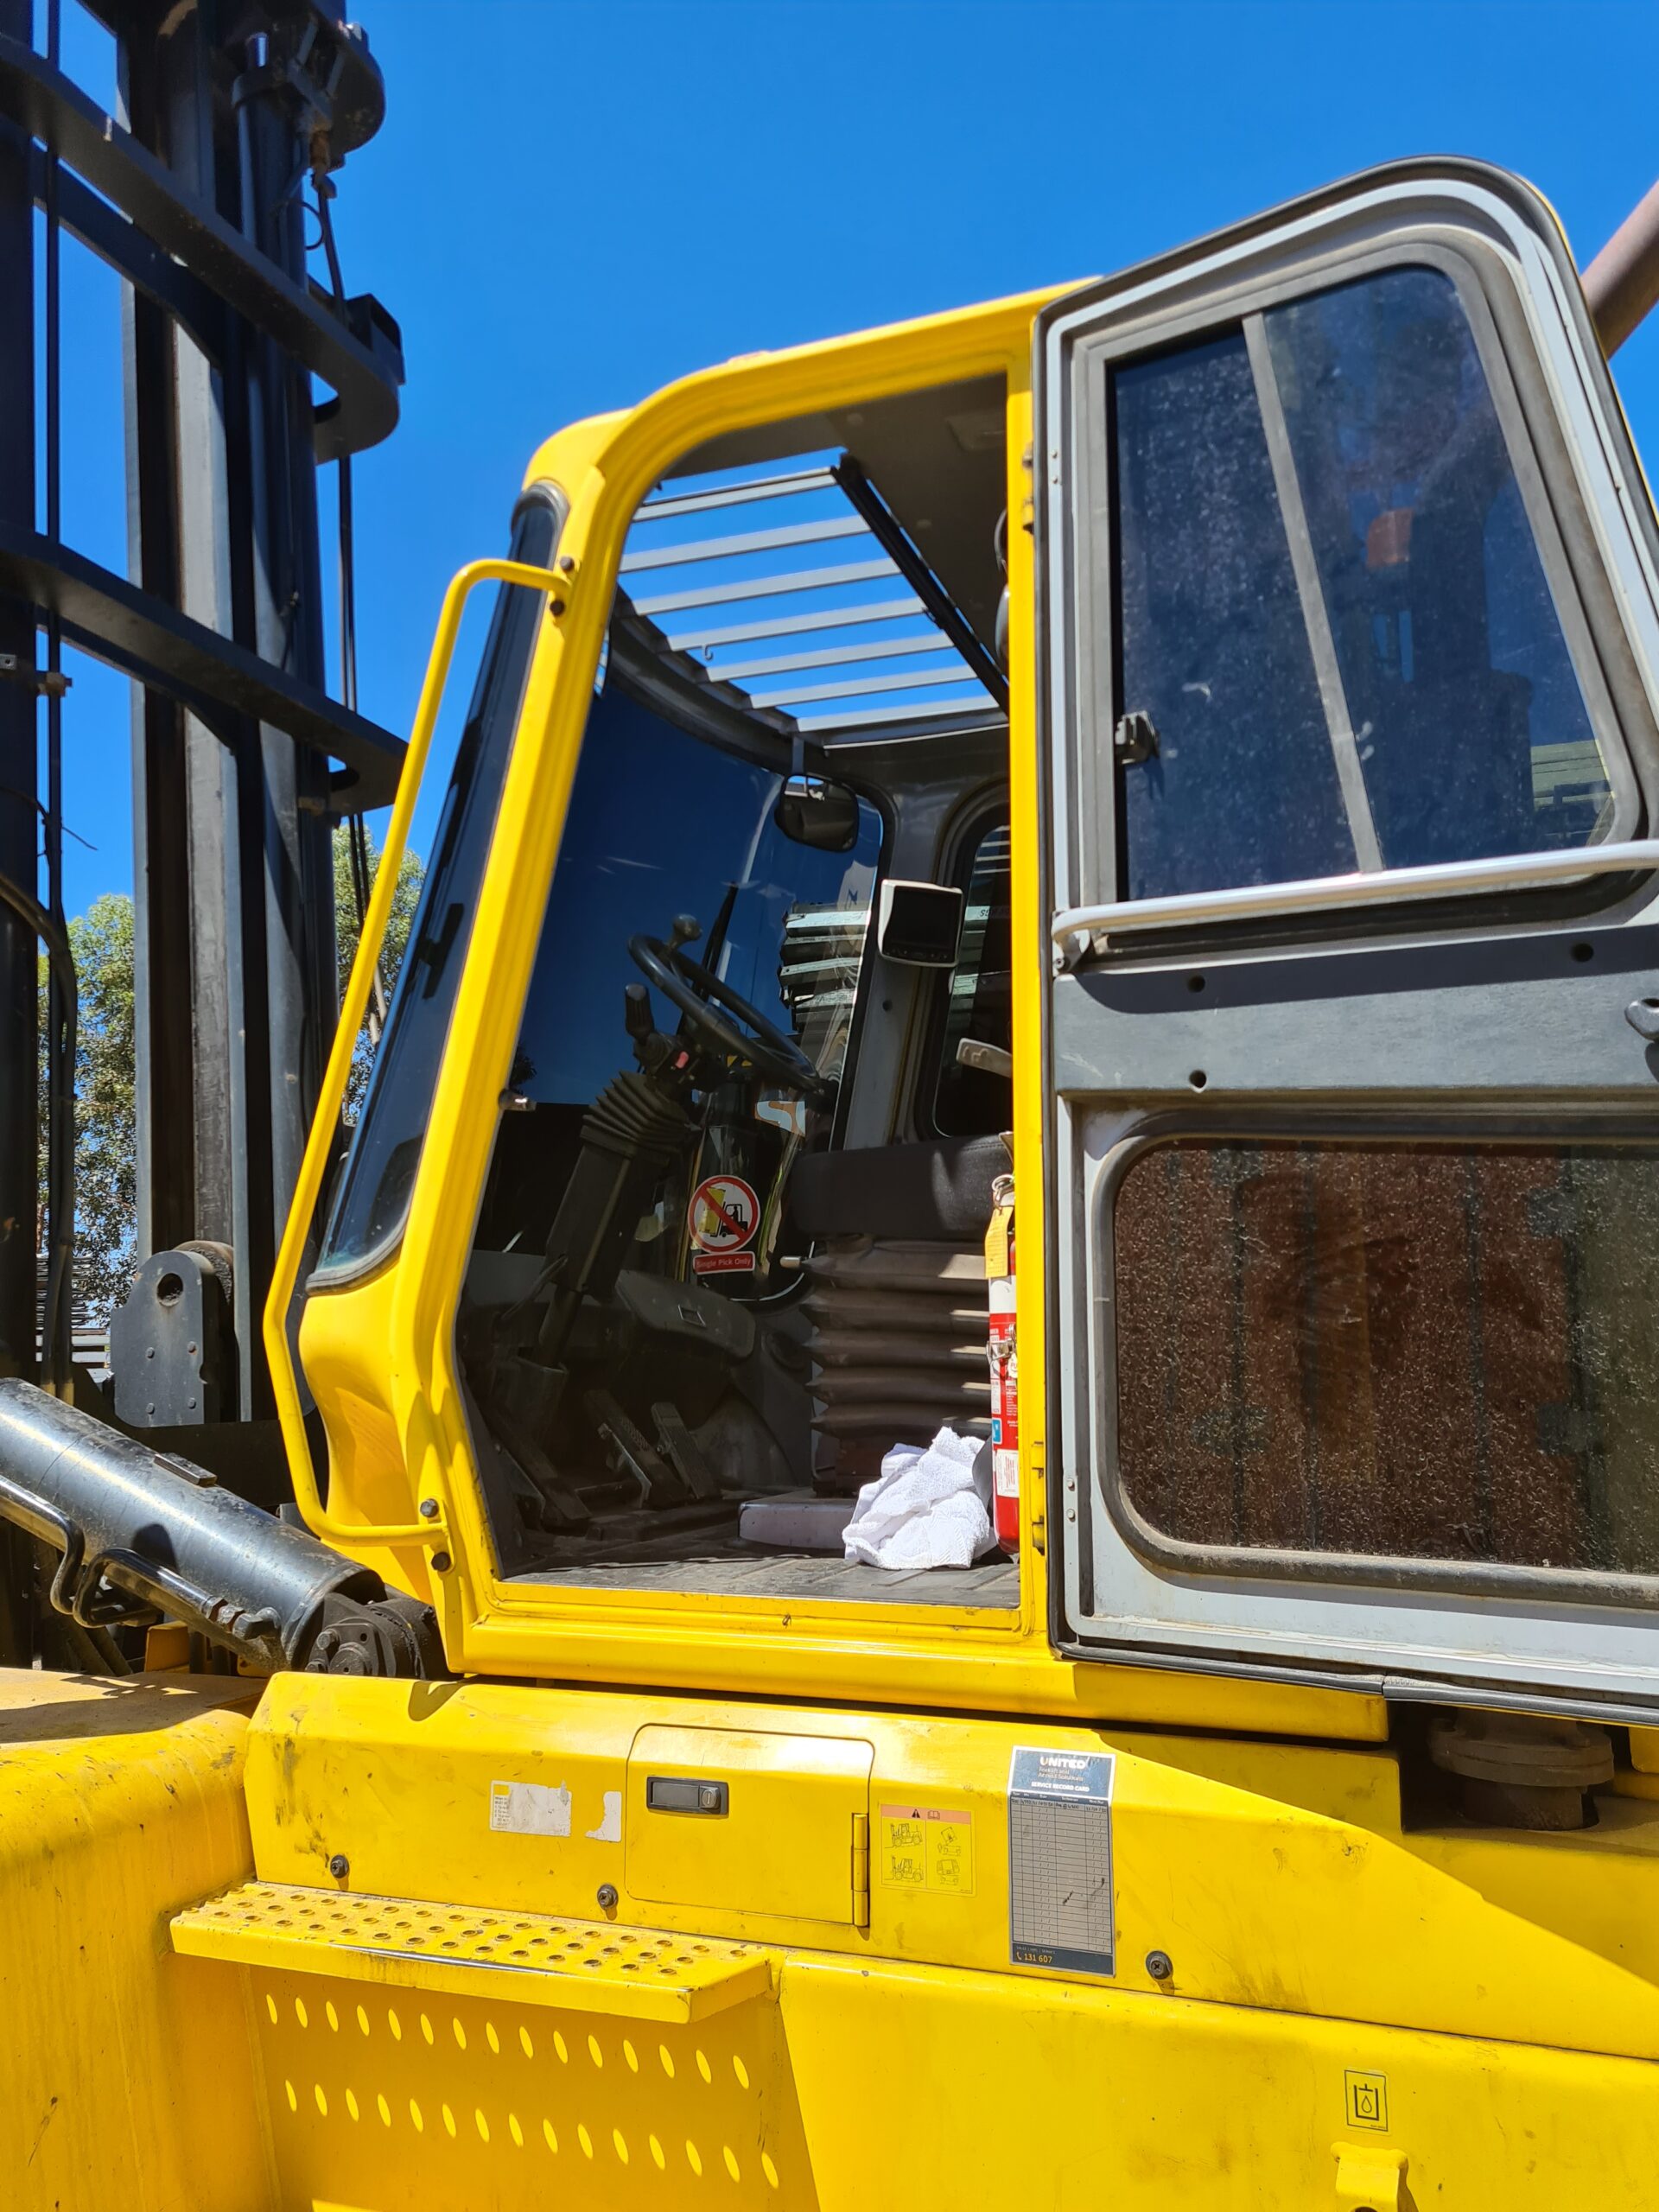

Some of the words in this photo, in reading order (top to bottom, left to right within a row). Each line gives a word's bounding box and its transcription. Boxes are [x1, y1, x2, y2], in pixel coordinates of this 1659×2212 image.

[734, 1257, 751, 1267] Only
[1039, 1756, 1086, 1770] UNITED
[1024, 1953, 1037, 1961] 131
[1039, 1955, 1052, 1963] 607
